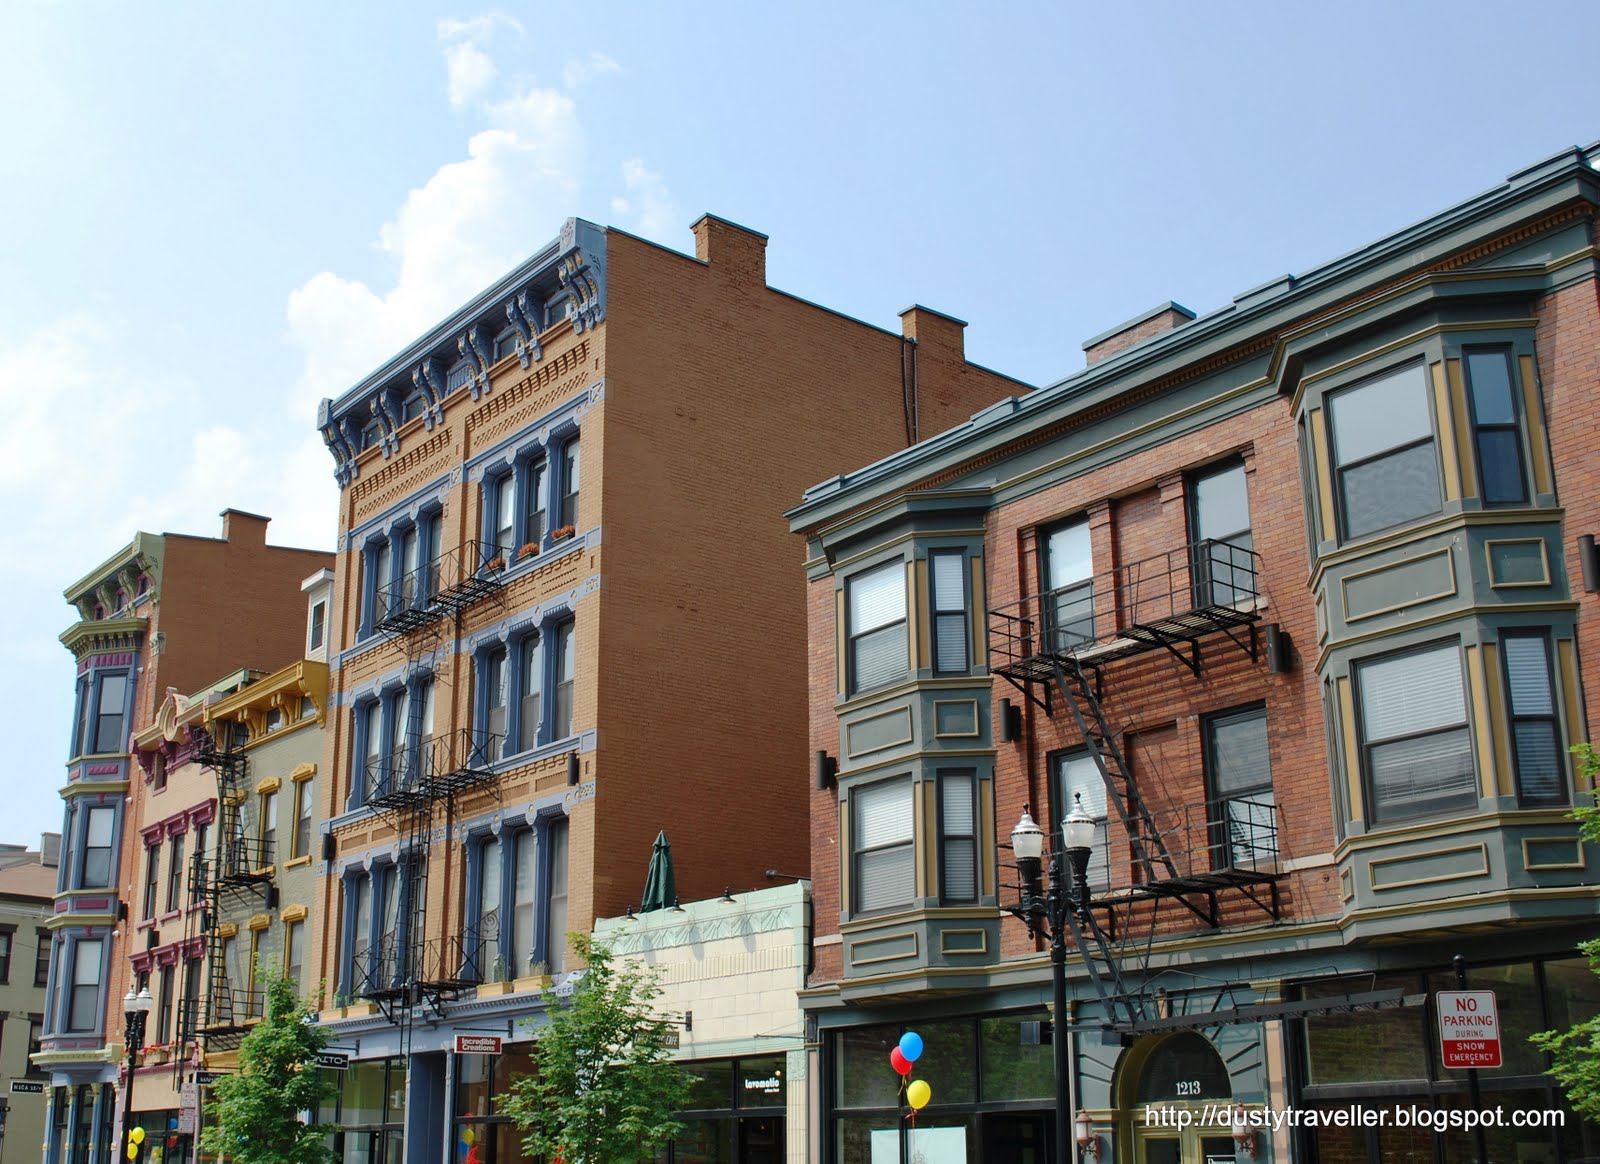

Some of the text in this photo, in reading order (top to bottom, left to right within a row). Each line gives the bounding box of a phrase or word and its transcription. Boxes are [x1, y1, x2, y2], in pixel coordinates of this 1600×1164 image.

[1455, 998, 1477, 1012] NO
[1443, 1015, 1493, 1026] PARKING
[1455, 1030, 1484, 1038] DURING
[461, 1037, 496, 1046] Incredible
[462, 1043, 496, 1052] Creations
[1456, 1042, 1486, 1051] SNOW
[1449, 1052, 1493, 1062] EMERGENCY
[1175, 1080, 1201, 1096] 1213
